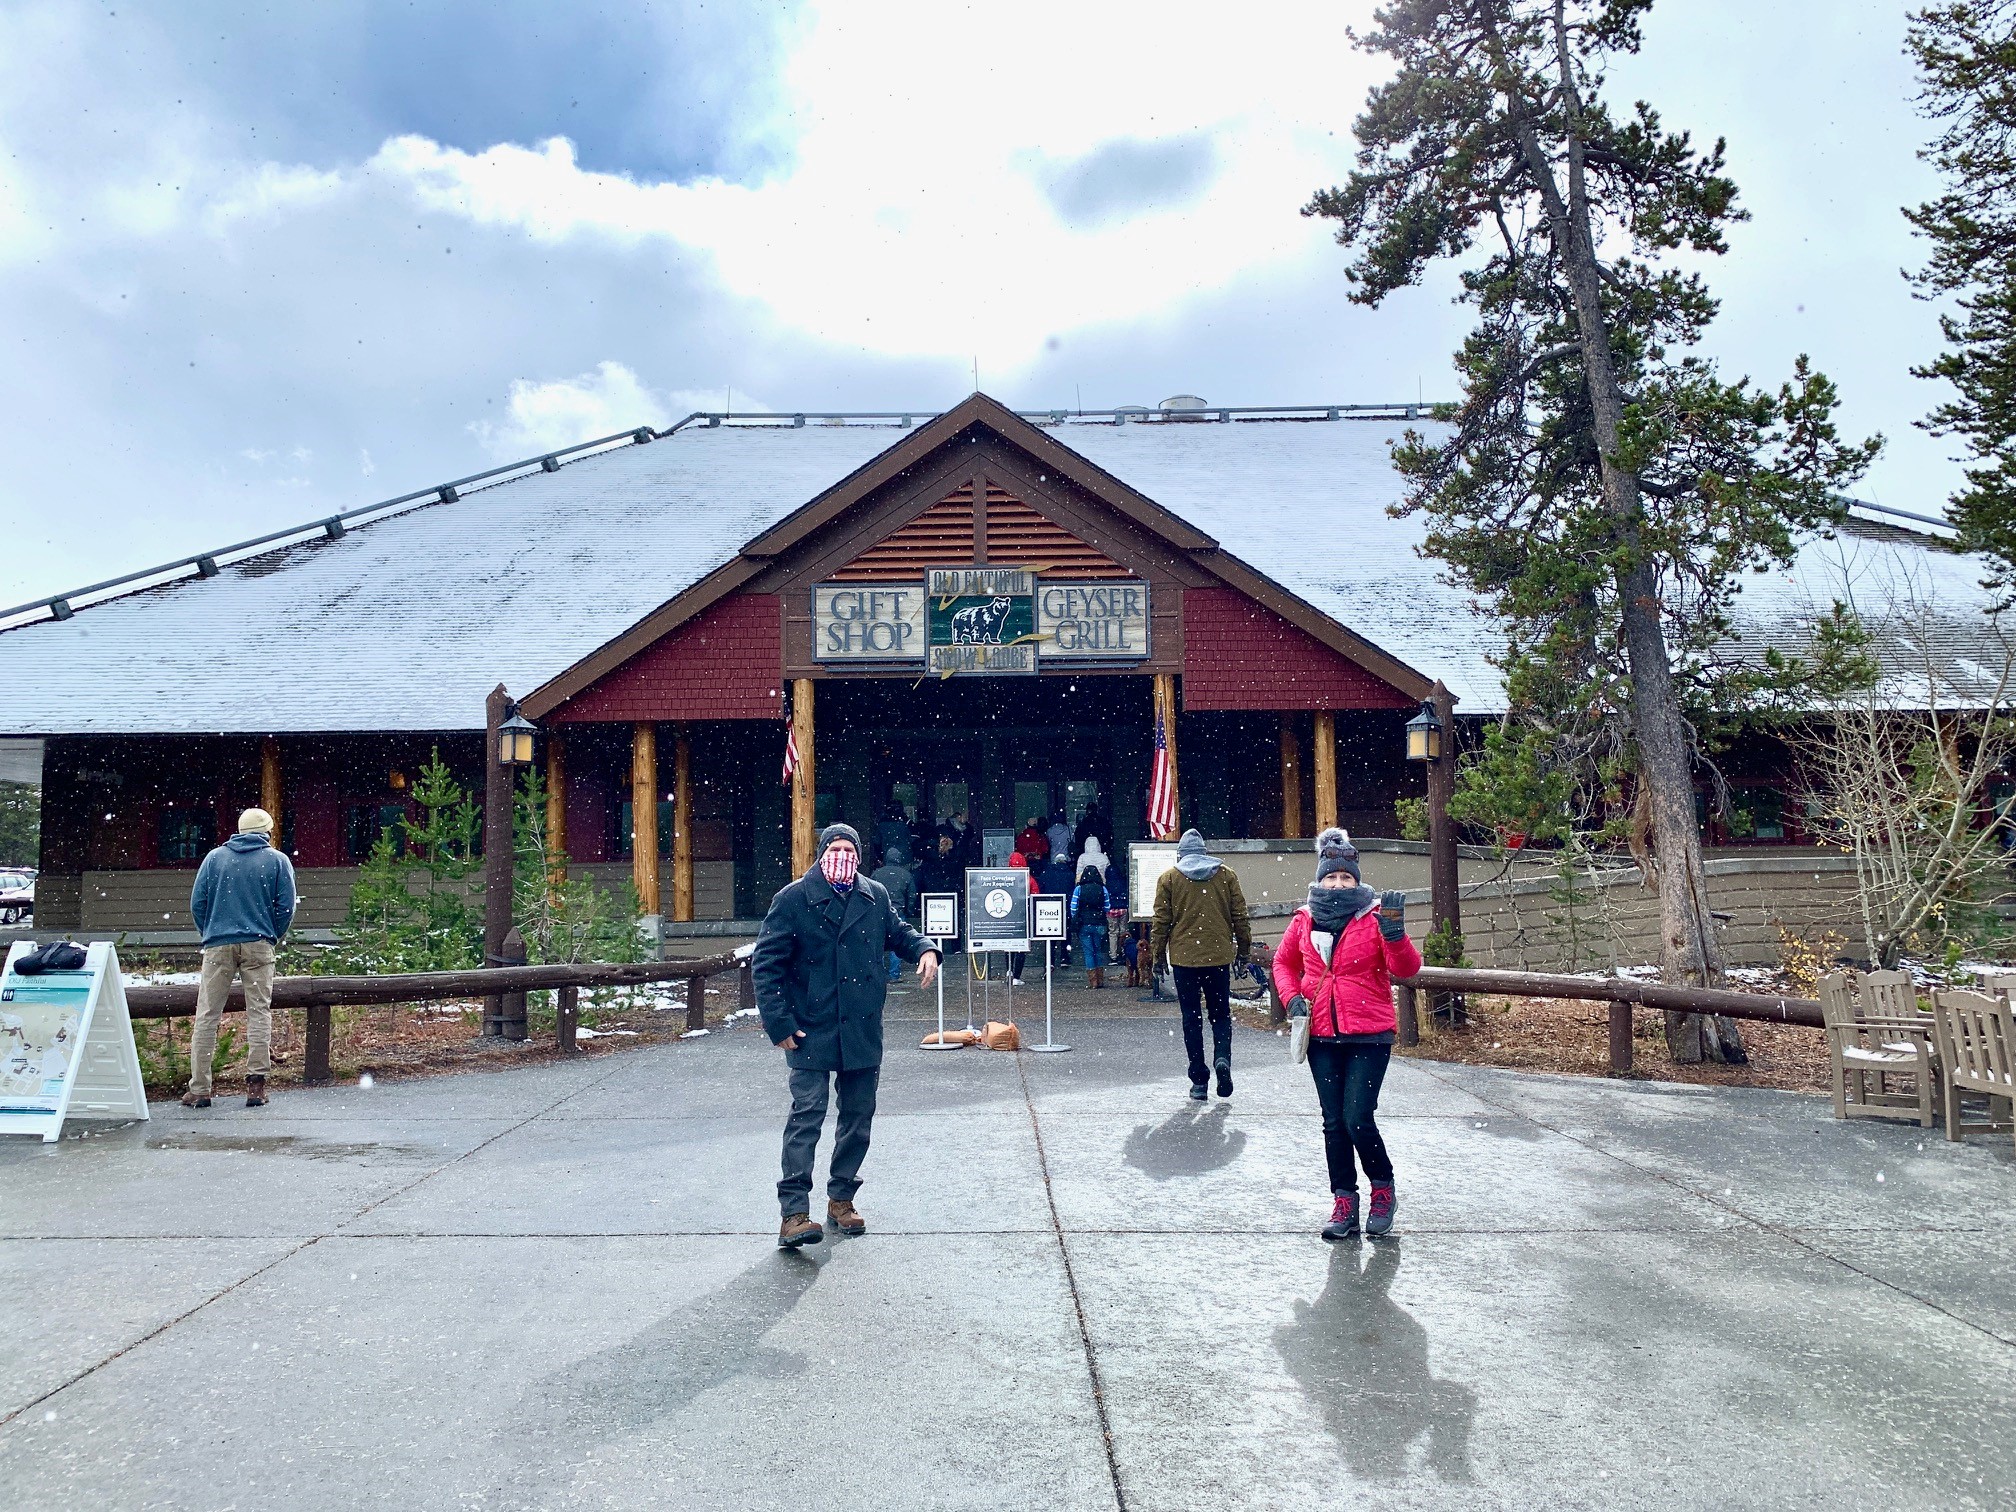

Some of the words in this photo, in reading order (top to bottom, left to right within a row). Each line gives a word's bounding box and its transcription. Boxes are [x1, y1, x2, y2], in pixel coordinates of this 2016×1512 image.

[830, 591, 909, 621] GIFT
[1043, 588, 1144, 619] GEYSER
[827, 621, 913, 652] SHOP
[1055, 619, 1132, 650] GRILL
